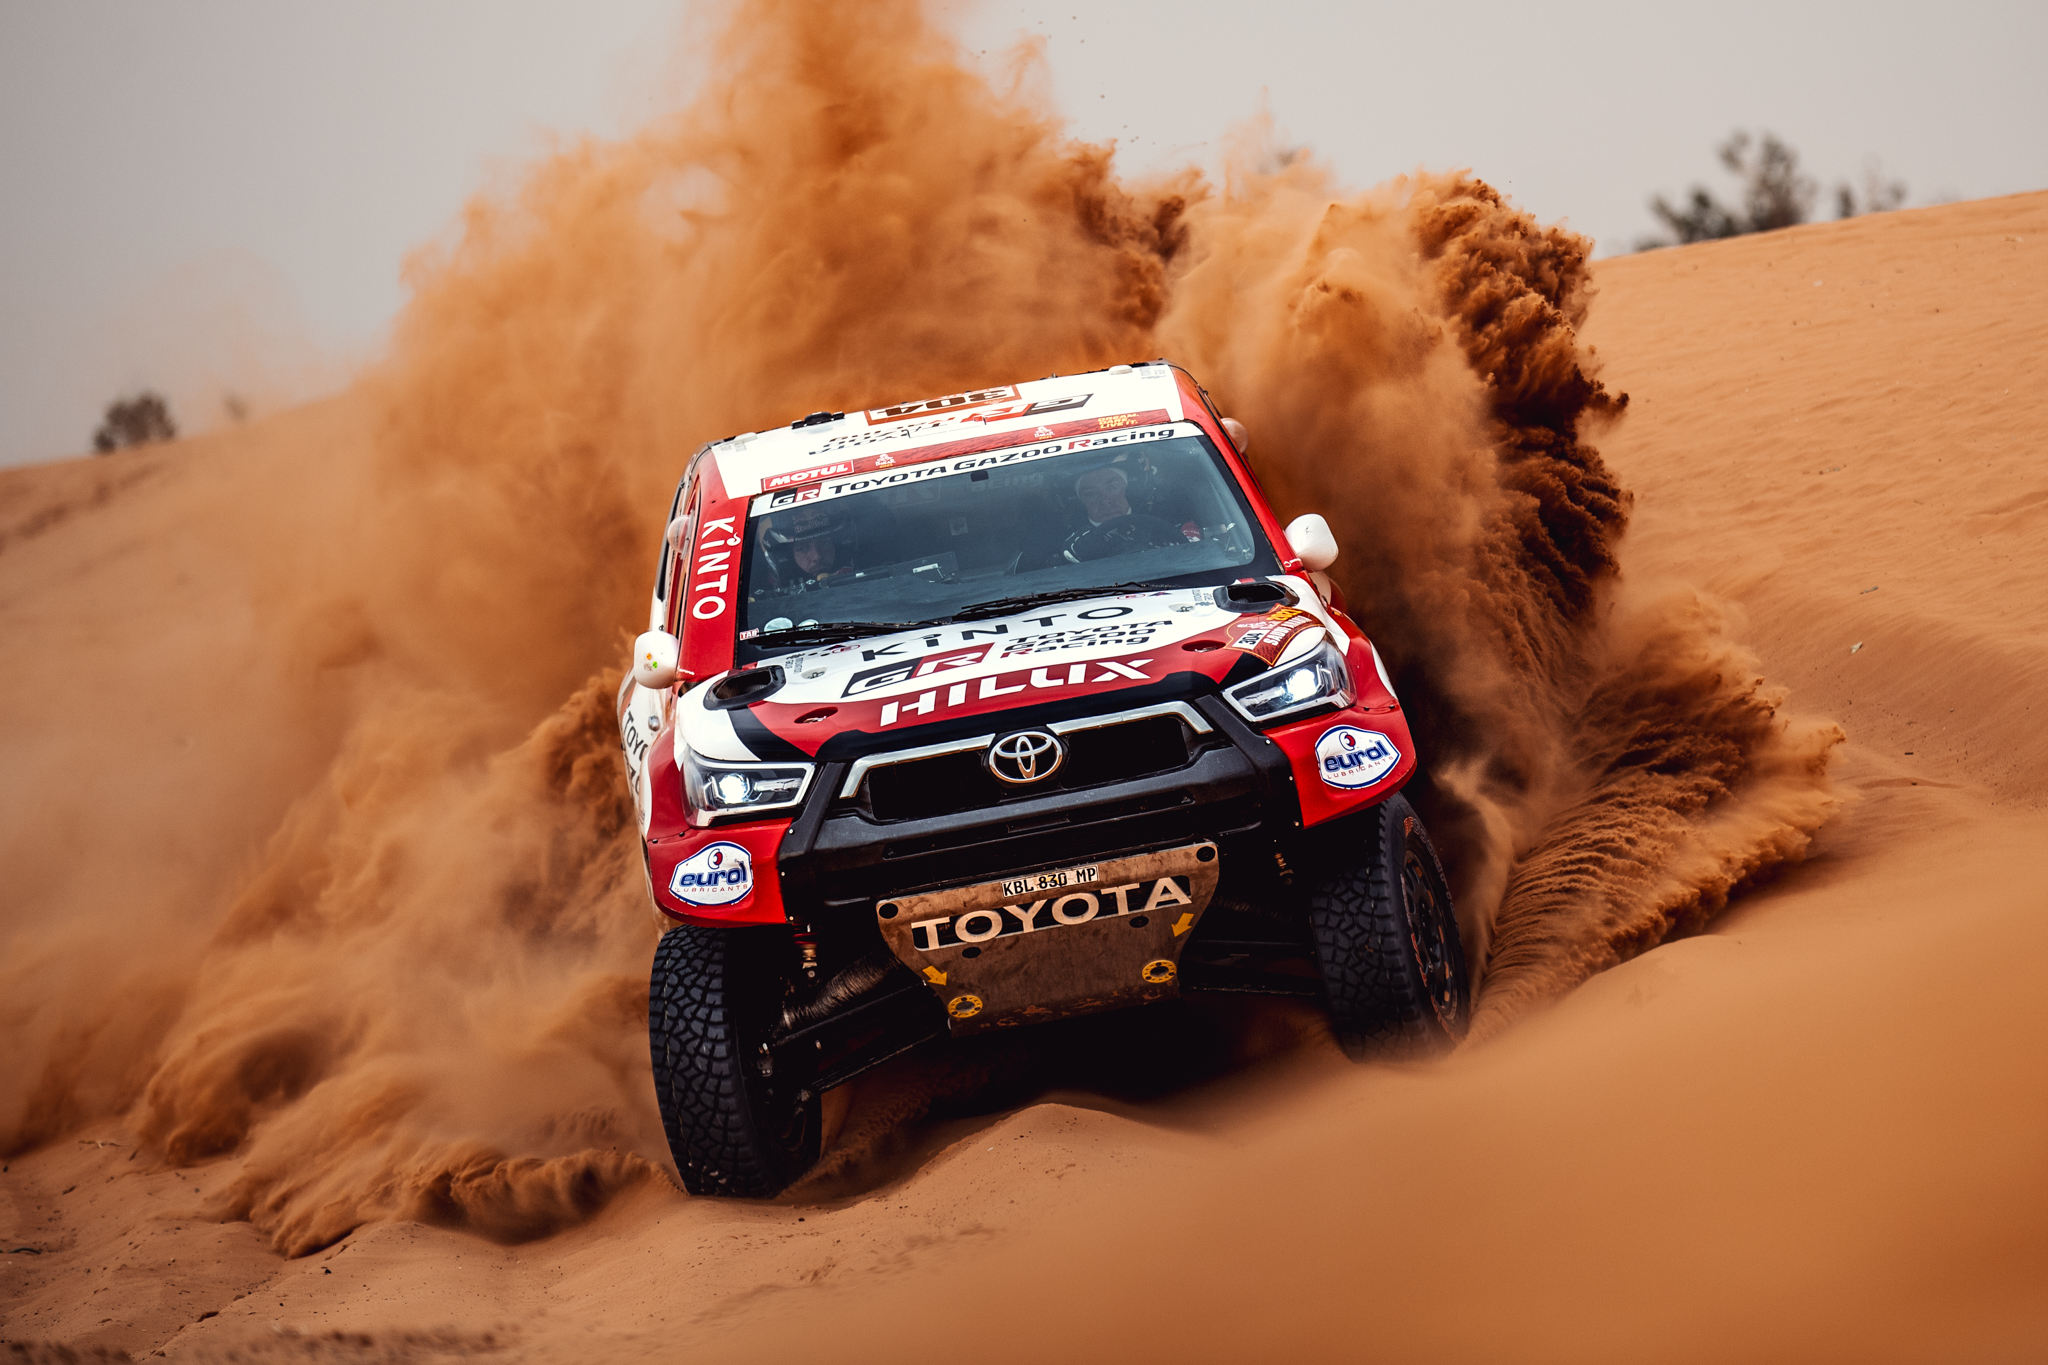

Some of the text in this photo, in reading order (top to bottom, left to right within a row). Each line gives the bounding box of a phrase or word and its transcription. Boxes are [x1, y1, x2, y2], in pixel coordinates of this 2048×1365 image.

[877, 389, 1007, 416] 304
[769, 463, 849, 488] MOTUL
[771, 427, 1175, 508] GR TOYOTA GAZOO Racing
[1004, 628, 1156, 652] GAZOO
[1009, 620, 1173, 643] TOYOTA
[1000, 636, 1150, 659] Racing
[846, 650, 986, 696] GR
[880, 658, 1154, 728] HILUX
[1324, 739, 1390, 773] eurol
[1327, 755, 1394, 780] LUBRICANTS
[679, 860, 748, 887] eurol
[1003, 867, 1096, 896] KBL 830 MP
[676, 884, 748, 893] LUBRICANTS
[910, 876, 1192, 951] TOYOTA
